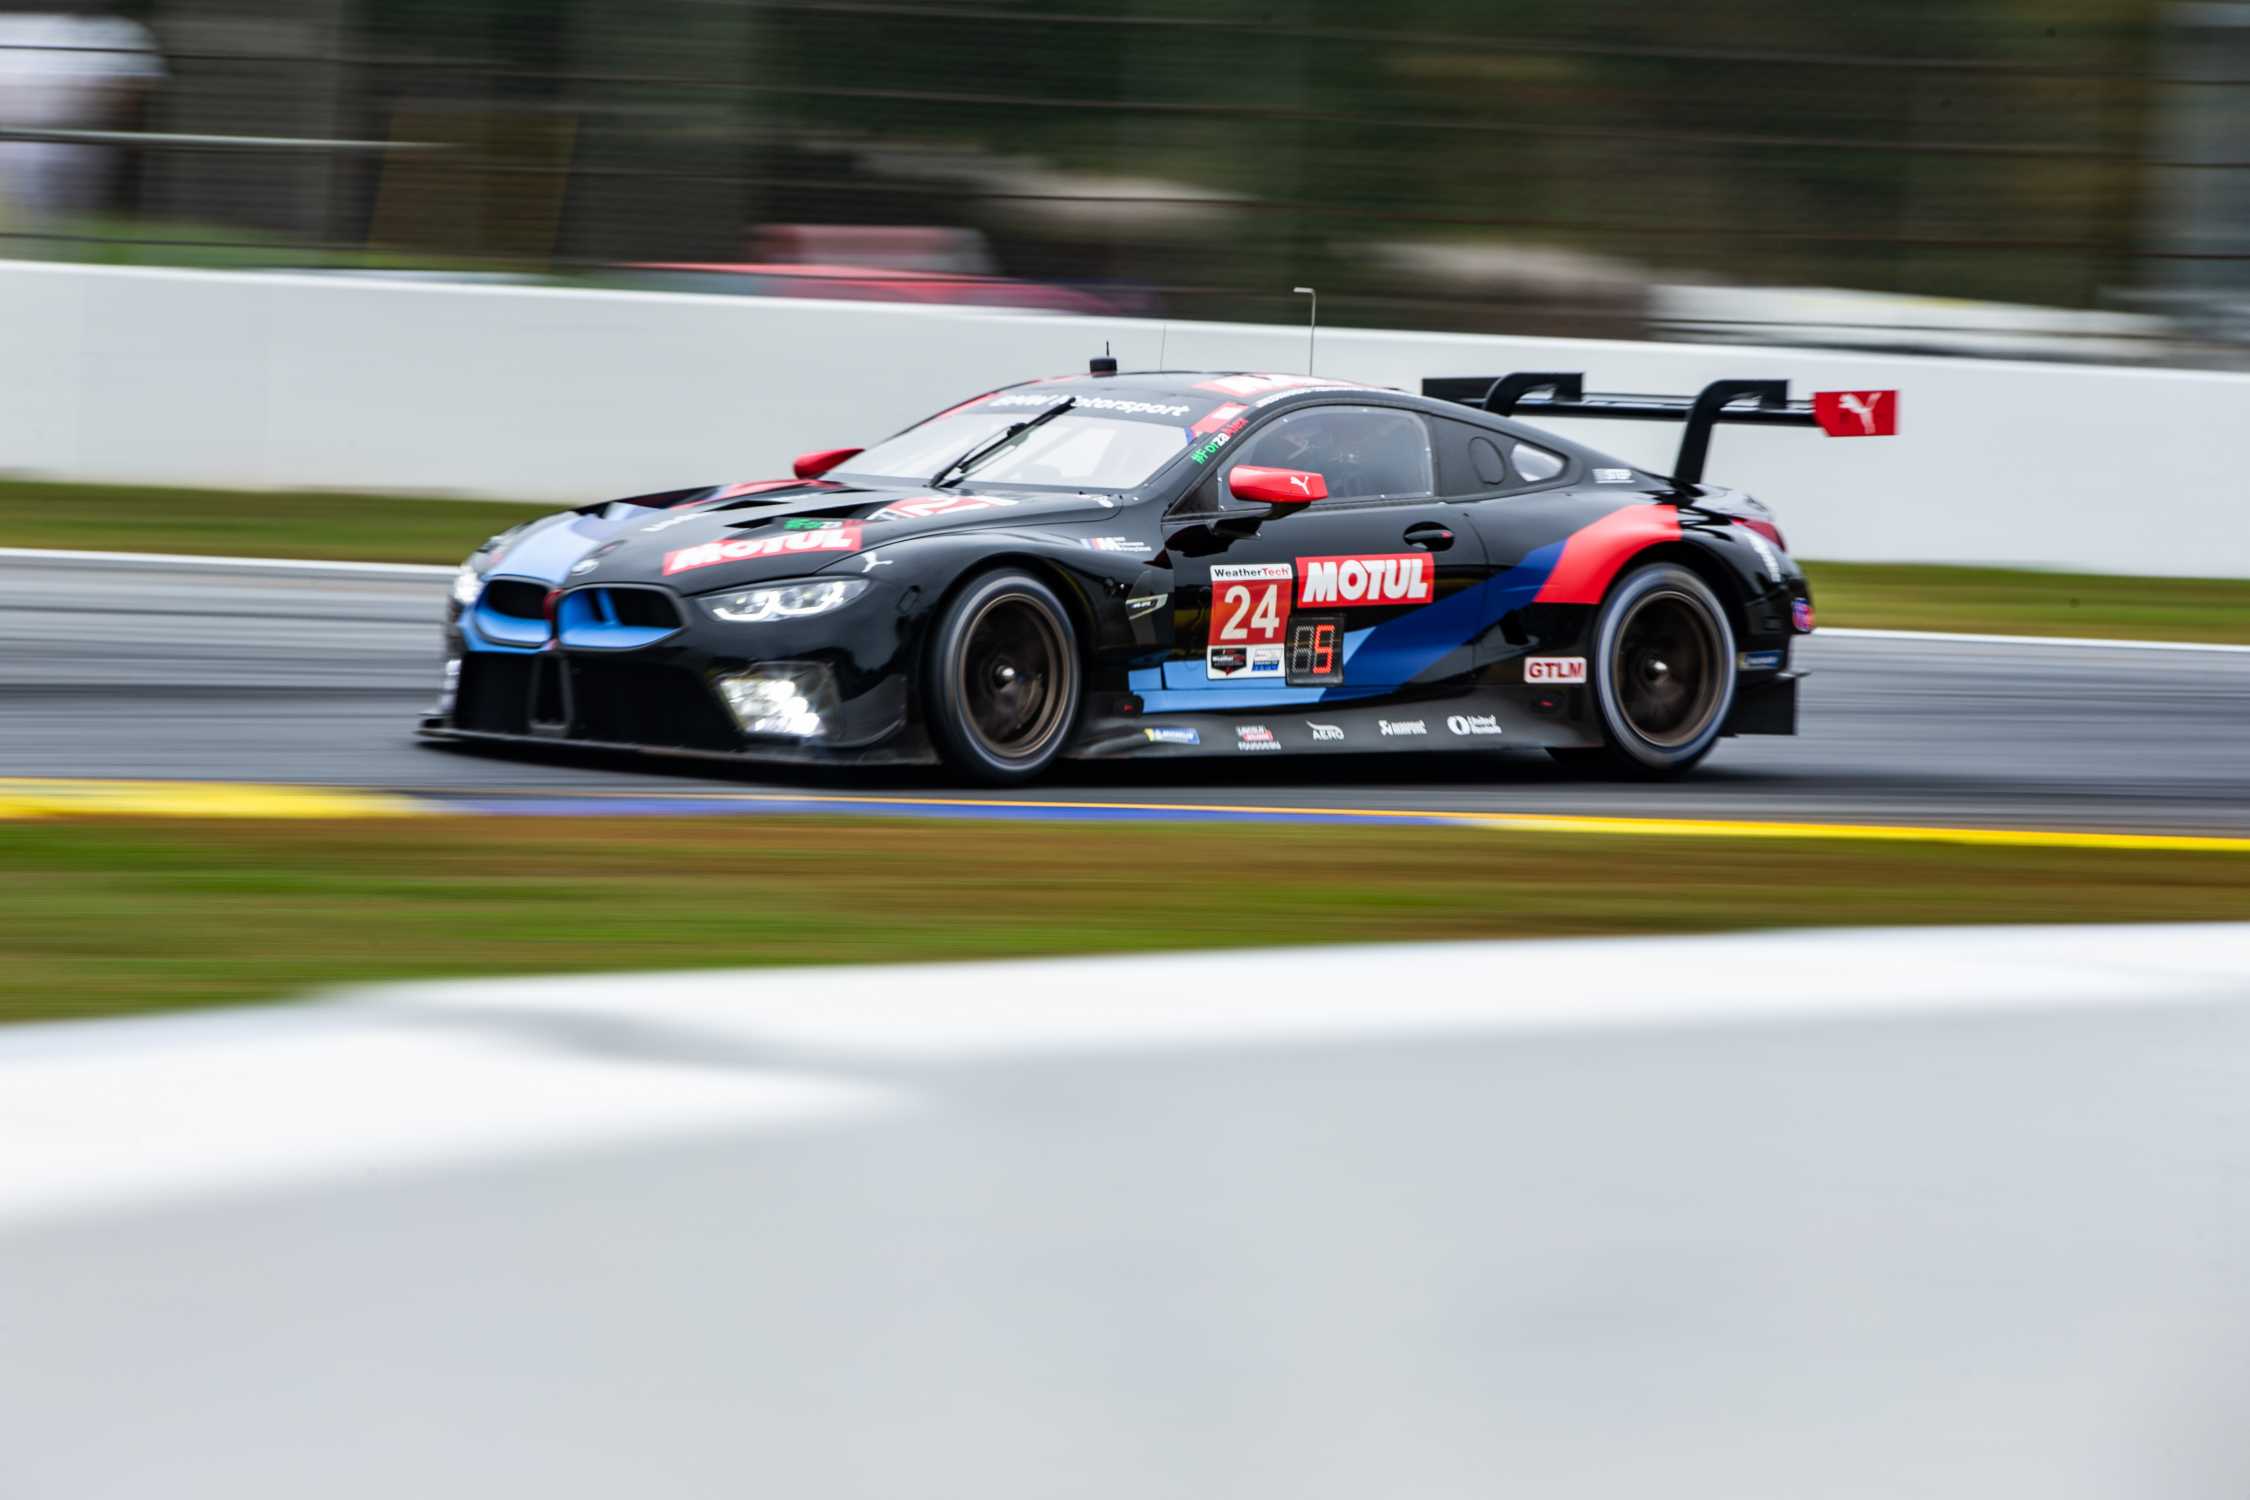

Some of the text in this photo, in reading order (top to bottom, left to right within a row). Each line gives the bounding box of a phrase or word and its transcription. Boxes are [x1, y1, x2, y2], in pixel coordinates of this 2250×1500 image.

[669, 528, 853, 572] MOTUL
[1214, 566, 1289, 578] WeatherTech
[1302, 559, 1429, 602] MOTUL
[1220, 584, 1280, 640] 24
[1529, 662, 1585, 678] GTLM
